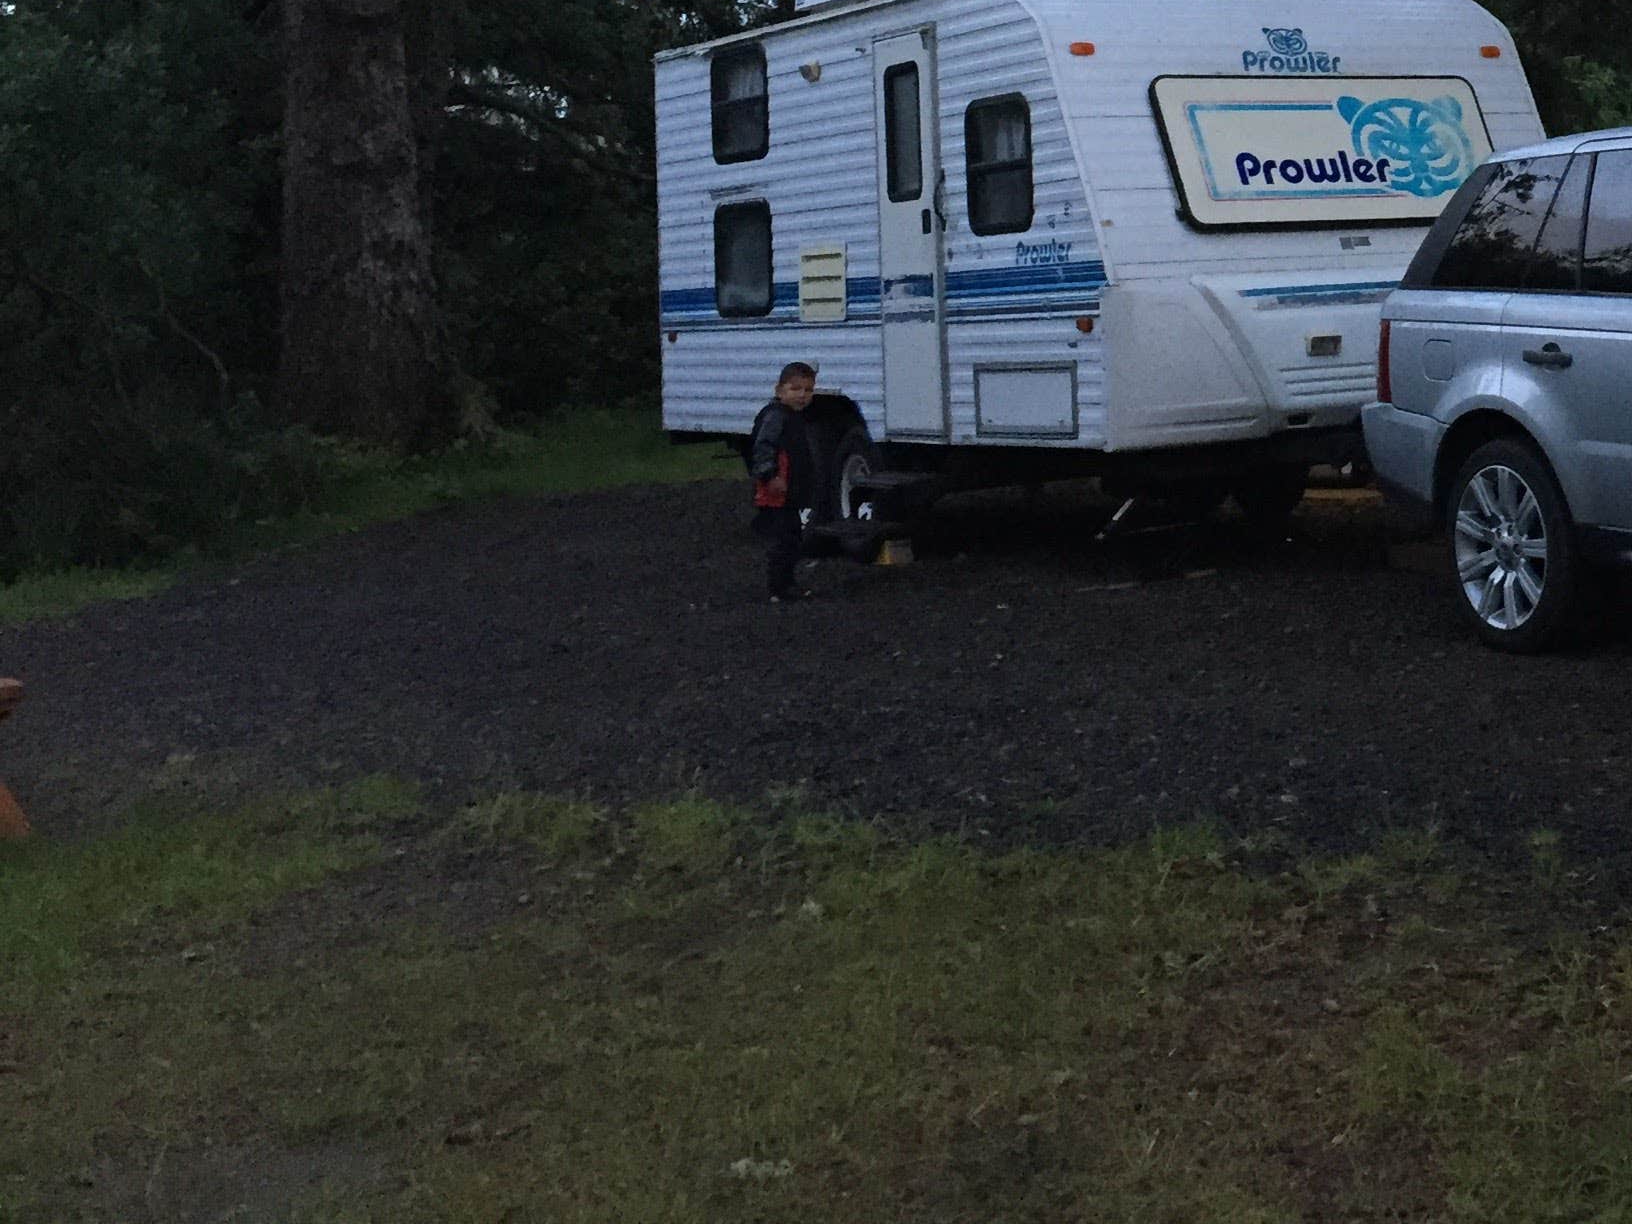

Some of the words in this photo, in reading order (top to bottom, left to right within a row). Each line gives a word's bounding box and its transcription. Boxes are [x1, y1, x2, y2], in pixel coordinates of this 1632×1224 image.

[1242, 50, 1341, 73] Prowler
[1235, 150, 1391, 185] Prowler
[1015, 238, 1072, 265] Prowler
